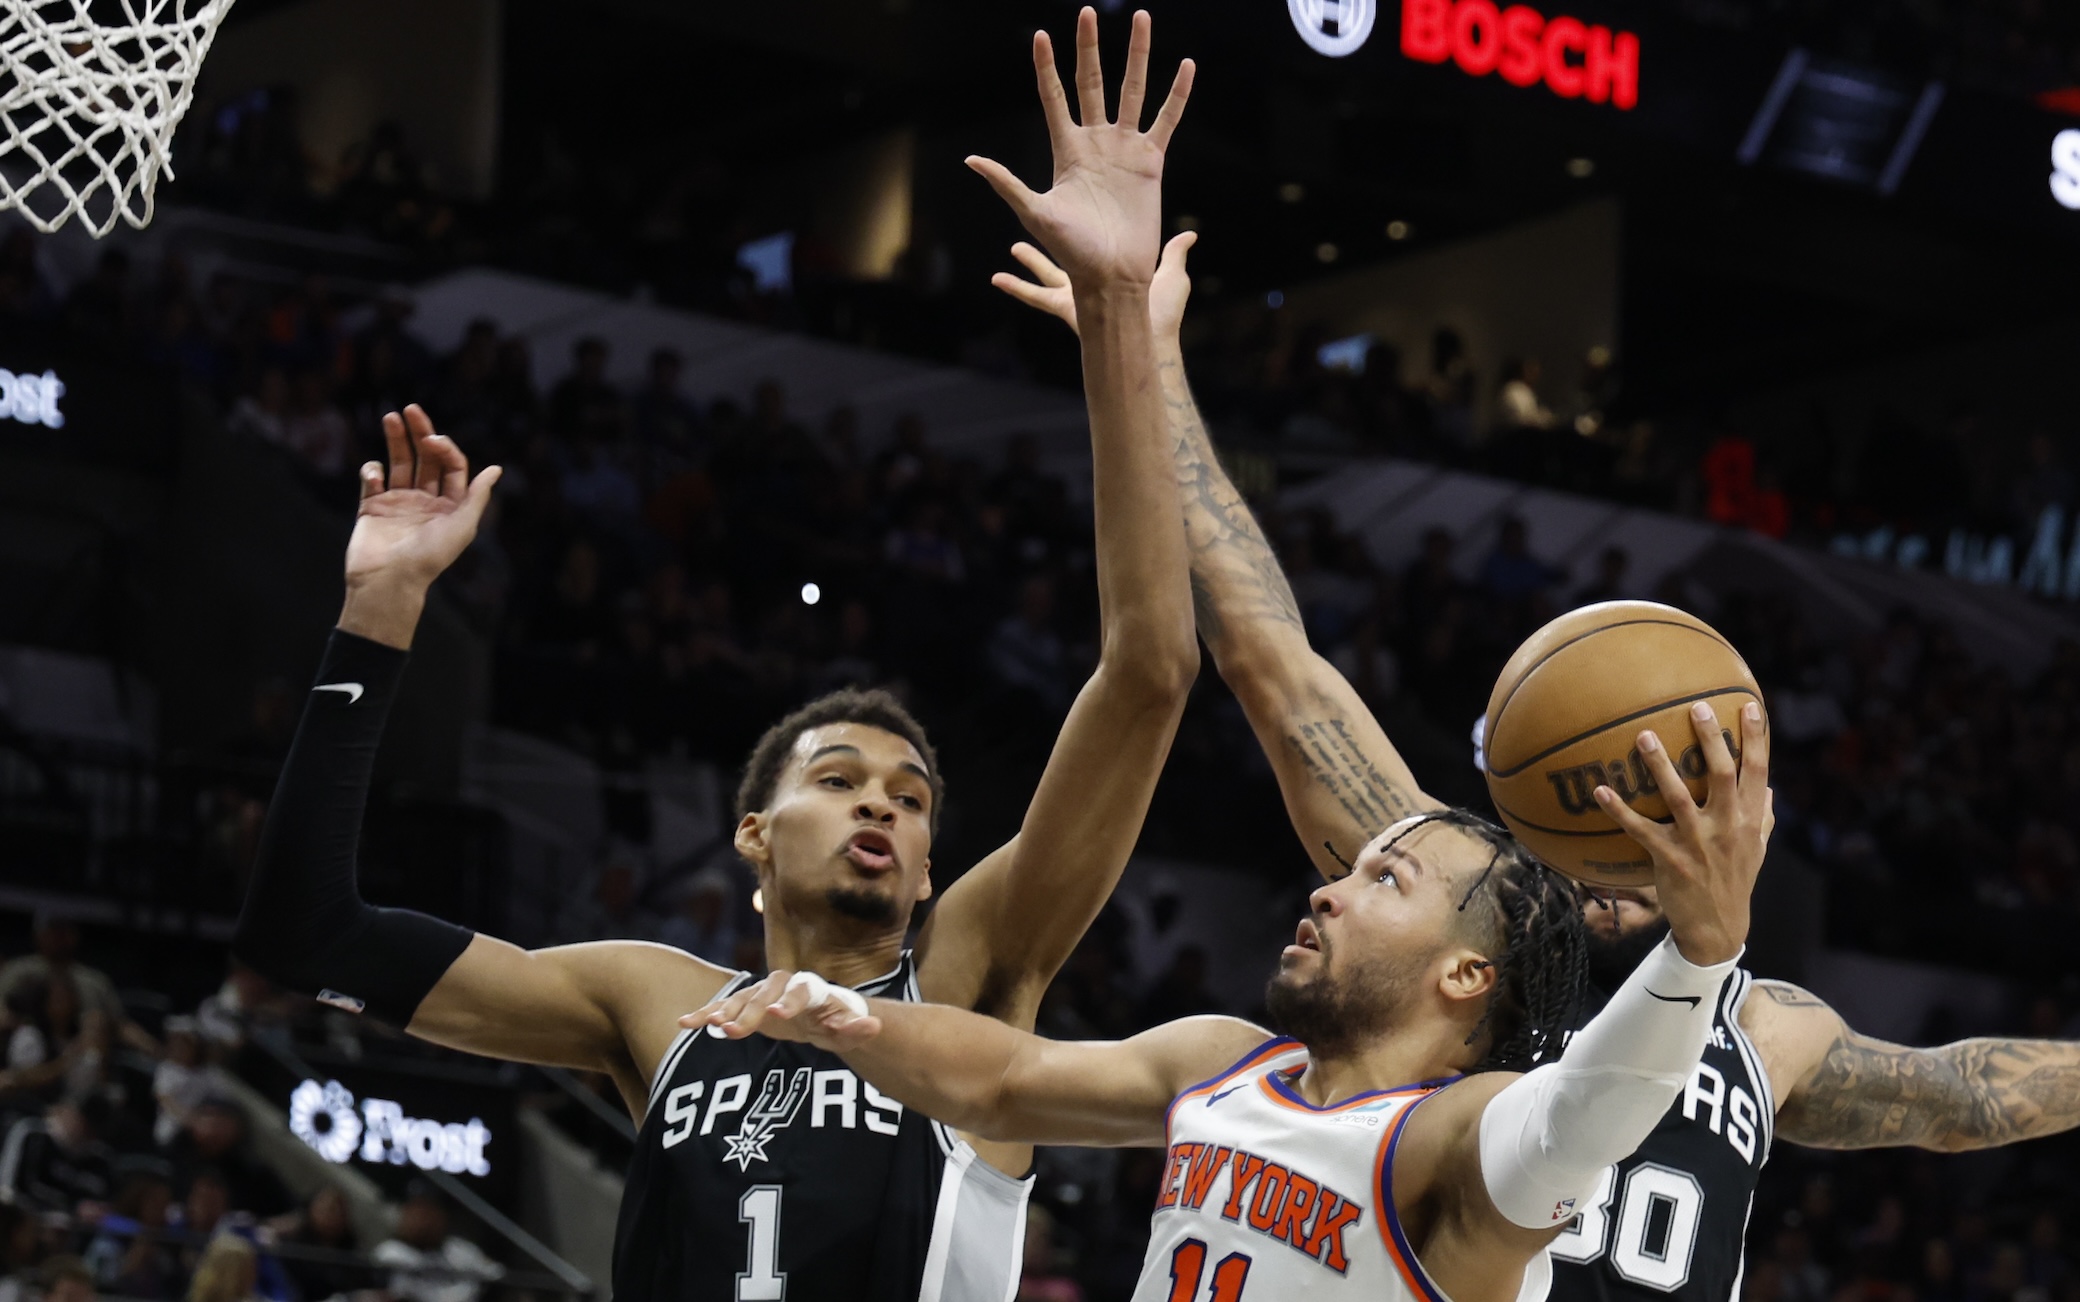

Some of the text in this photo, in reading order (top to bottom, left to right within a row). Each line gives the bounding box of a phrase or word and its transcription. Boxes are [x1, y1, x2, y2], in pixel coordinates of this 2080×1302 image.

[1400, 0, 1640, 110] BOSCH
[1546, 728, 1740, 815] Wilo
[361, 1098, 491, 1177] Frost
[735, 1184, 787, 1302] 1
[1220, 1148, 1364, 1278] YORK
